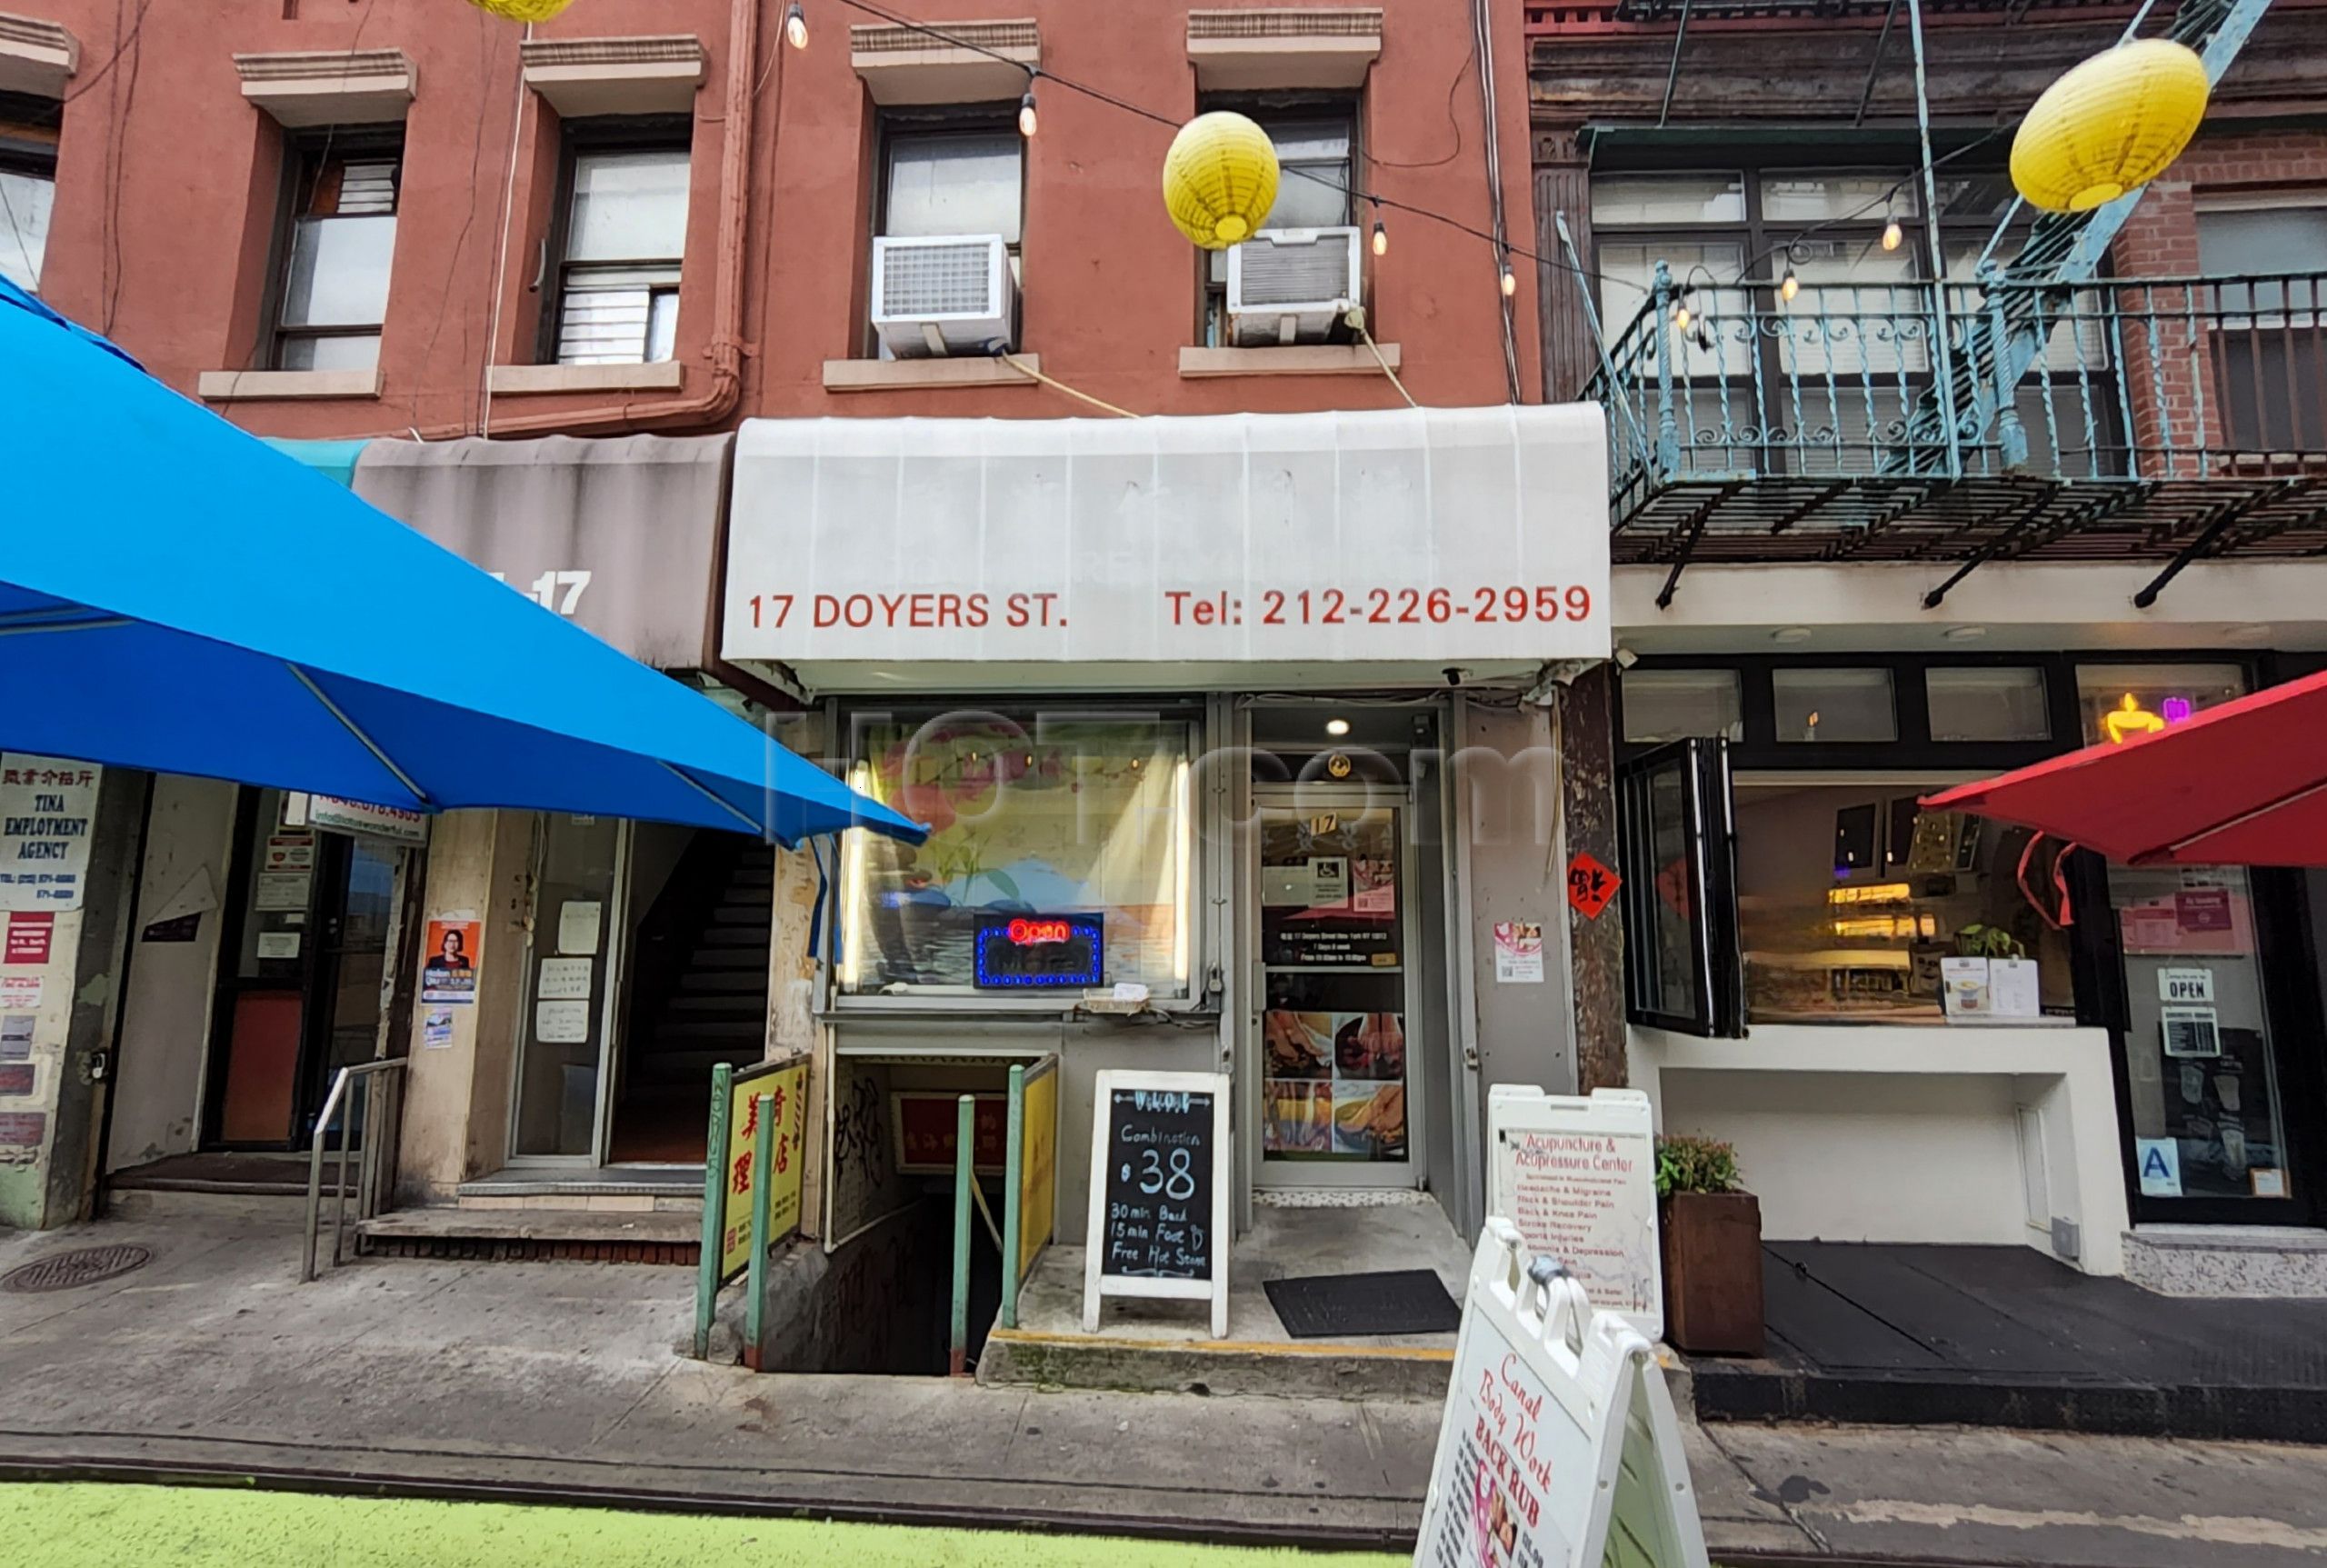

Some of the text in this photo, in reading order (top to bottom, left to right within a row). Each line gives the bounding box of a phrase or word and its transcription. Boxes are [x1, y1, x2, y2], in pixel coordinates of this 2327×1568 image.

[748, 593, 1068, 629] 17 DOYERS ST.
[1164, 584, 1592, 626] Tel: 212-226-2959
[35, 794, 65, 813] TINA
[4, 817, 88, 837] EMPLOYMENT
[1314, 814, 1335, 835] 17
[17, 841, 70, 860] AGENCY
[1008, 918, 1071, 945] Open
[2170, 982, 2205, 998] OPEN
[1526, 1134, 1616, 1153] Acupuncture &
[1515, 1149, 1633, 1173] Acupressure Center
[2142, 1146, 2172, 1178] A
[1517, 1184, 1561, 1193] Headache
[1573, 1186, 1612, 1197] Migraine
[1517, 1194, 1539, 1203] Neck
[1594, 1199, 1615, 1208] Pain
[1577, 1211, 1598, 1219] Pain
[1550, 1221, 1592, 1233] Recovery
[1112, 1241, 1139, 1261] Free
[1148, 1244, 1170, 1266] Hot
[1572, 1246, 1624, 1258] Depression
[1501, 1353, 1543, 1423] Canal
[1479, 1368, 1507, 1436] Body
[1513, 1413, 1553, 1495] Work
[1508, 1467, 1541, 1528] RUB
